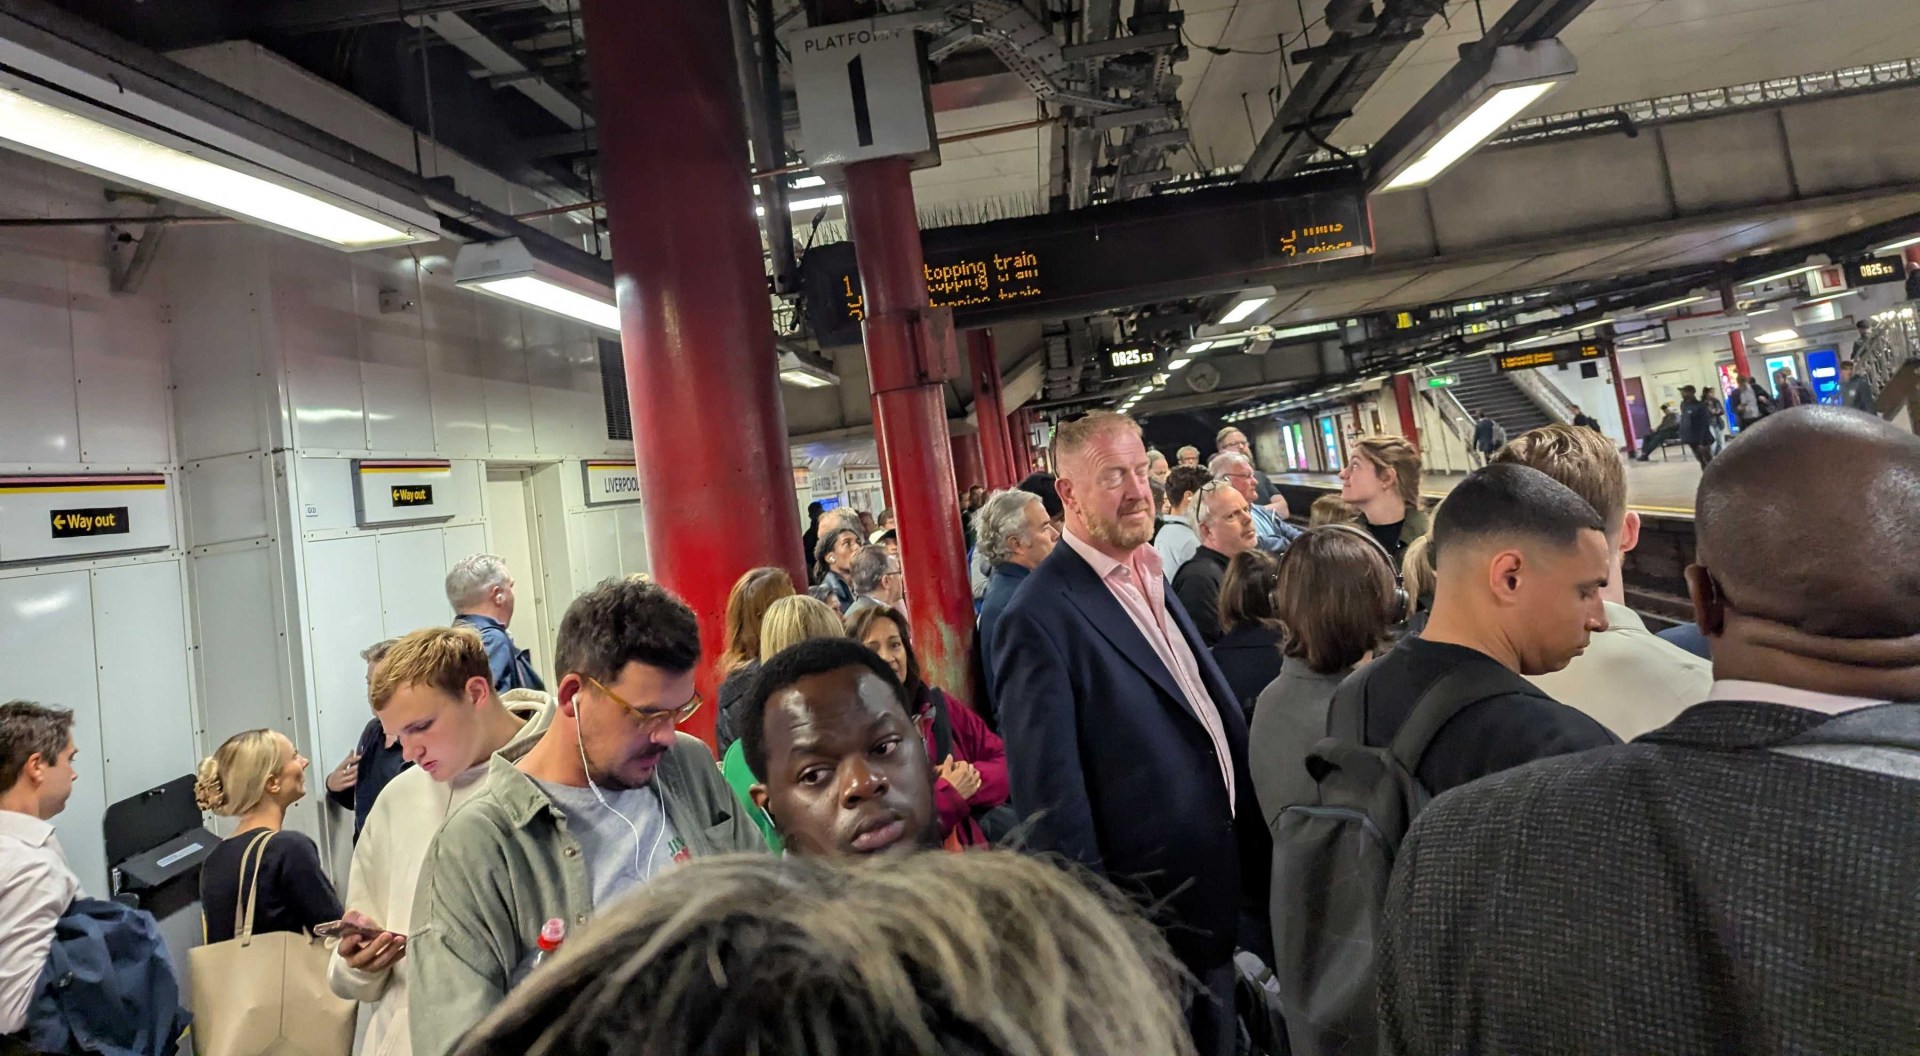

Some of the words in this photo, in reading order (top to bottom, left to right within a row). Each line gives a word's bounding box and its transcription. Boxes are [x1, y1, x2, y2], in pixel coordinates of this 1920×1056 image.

[804, 30, 900, 53] PLATFO
[847, 53, 873, 147] 1
[844, 275, 854, 297] 1
[994, 251, 1038, 271] train
[1860, 262, 1882, 278] 0825
[1111, 349, 1141, 367] 0825
[1141, 352, 1154, 363] 53
[604, 476, 640, 493] LIVERPOOL
[400, 489, 414, 503] Way
[415, 489, 426, 500] out
[67, 514, 93, 531] Way
[95, 513, 116, 528] out
